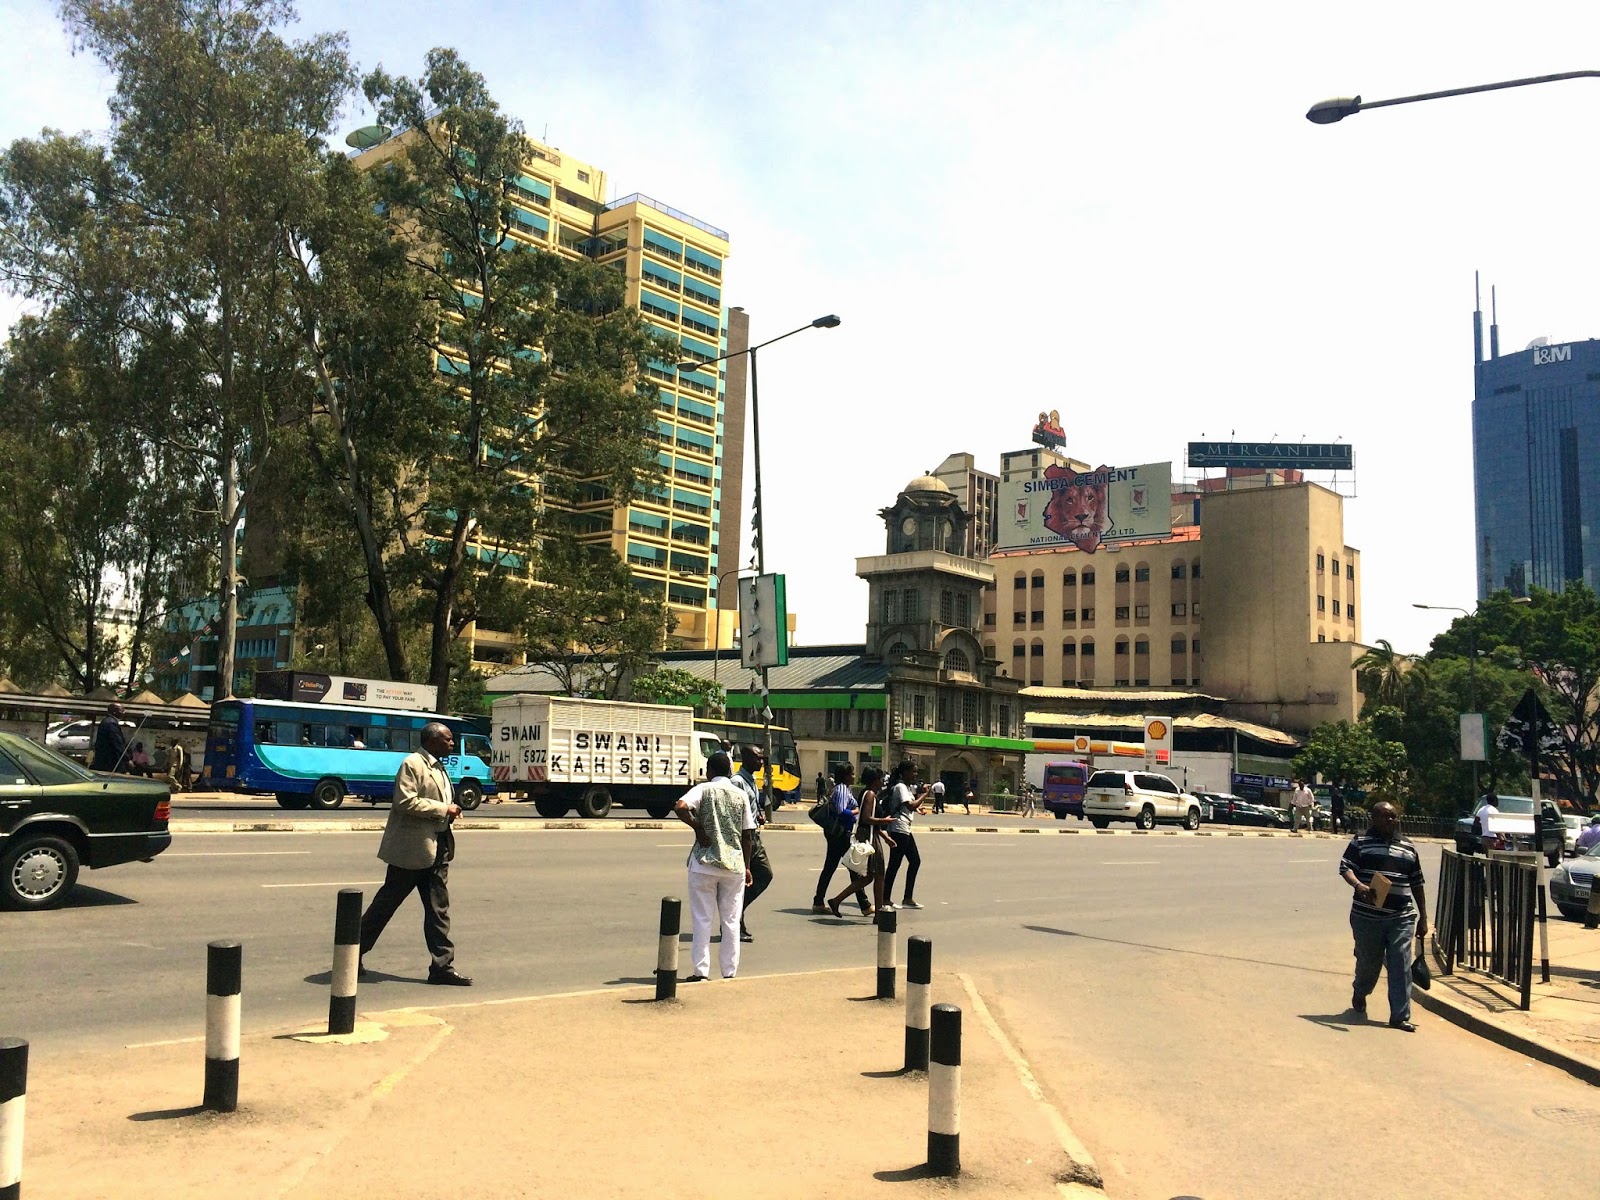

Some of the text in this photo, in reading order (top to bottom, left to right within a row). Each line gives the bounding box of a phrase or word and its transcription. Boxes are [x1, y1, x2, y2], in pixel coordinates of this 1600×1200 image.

[1207, 444, 1349, 457] MERCANTILE
[1024, 467, 1138, 493] SIMBA CEMENT
[1030, 534, 1069, 544] NATIONAL
[1070, 531, 1102, 540] CEMENT
[1105, 529, 1117, 537] CO
[501, 725, 541, 742] SWANI
[576, 733, 660, 753] SWANI
[492, 749, 547, 763] KAH 587Z
[551, 754, 688, 776] KAH 587Z
